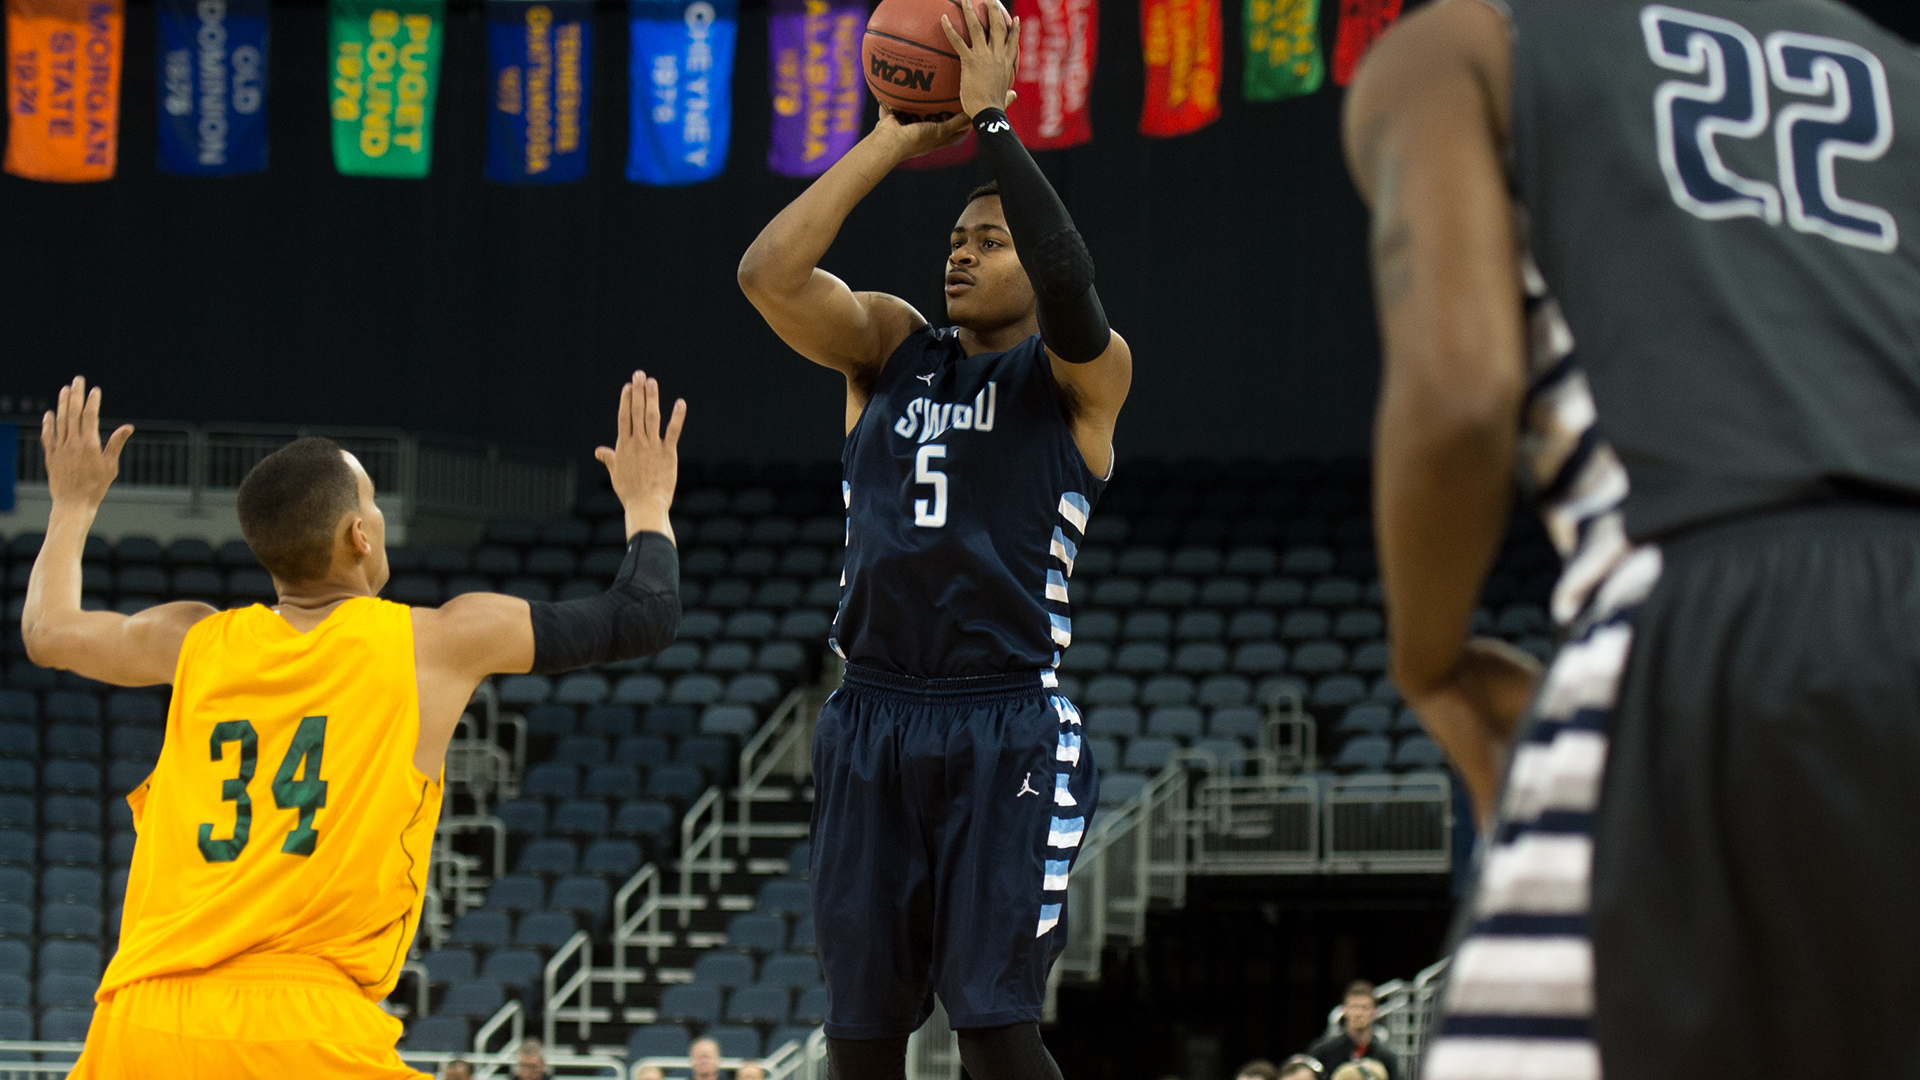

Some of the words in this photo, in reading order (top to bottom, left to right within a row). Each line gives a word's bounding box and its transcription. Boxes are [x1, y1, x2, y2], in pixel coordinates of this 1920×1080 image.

[48, 30, 79, 138] STATE
[84, 1, 114, 166] MORGAN
[196, 0, 228, 166] DOMINION
[231, 44, 262, 115] OLD
[359, 9, 401, 158] SOUND
[393, 14, 433, 153] PUGET
[683, 1, 716, 167] CHEYNEY
[800, 0, 831, 162] ALABAMA
[833, 15, 859, 133] NORTH
[871, 54, 936, 92] NCAA
[1639, 4, 1899, 254] 22
[914, 444, 949, 528] 5
[197, 715, 328, 864] 34
